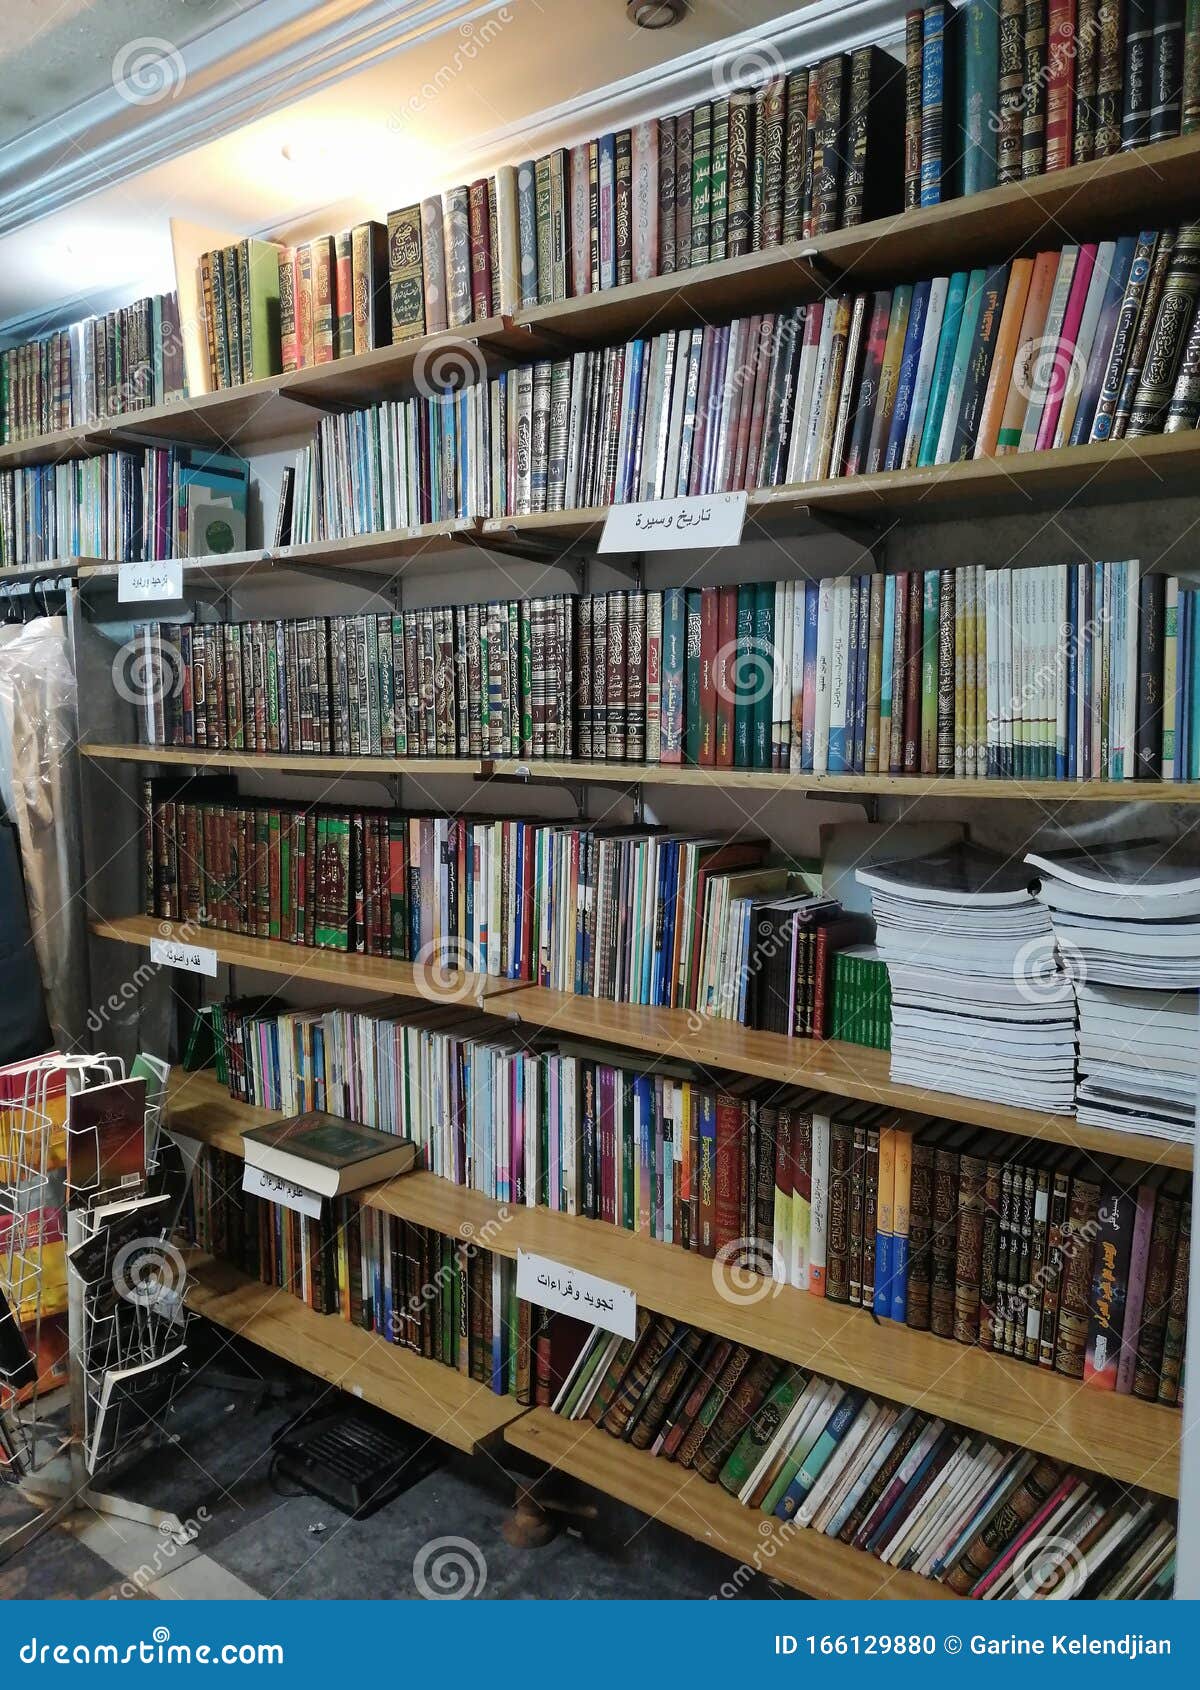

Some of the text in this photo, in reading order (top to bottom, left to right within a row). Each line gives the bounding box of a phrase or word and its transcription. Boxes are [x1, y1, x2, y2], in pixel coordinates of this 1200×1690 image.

[695, 154, 727, 183] تفسير
[394, 224, 413, 246] صحيح
[391, 241, 420, 266] البخاري
[635, 508, 712, 530] تاريخ وسيرة
[536, 1273, 614, 1313] تجويد وقراءات
